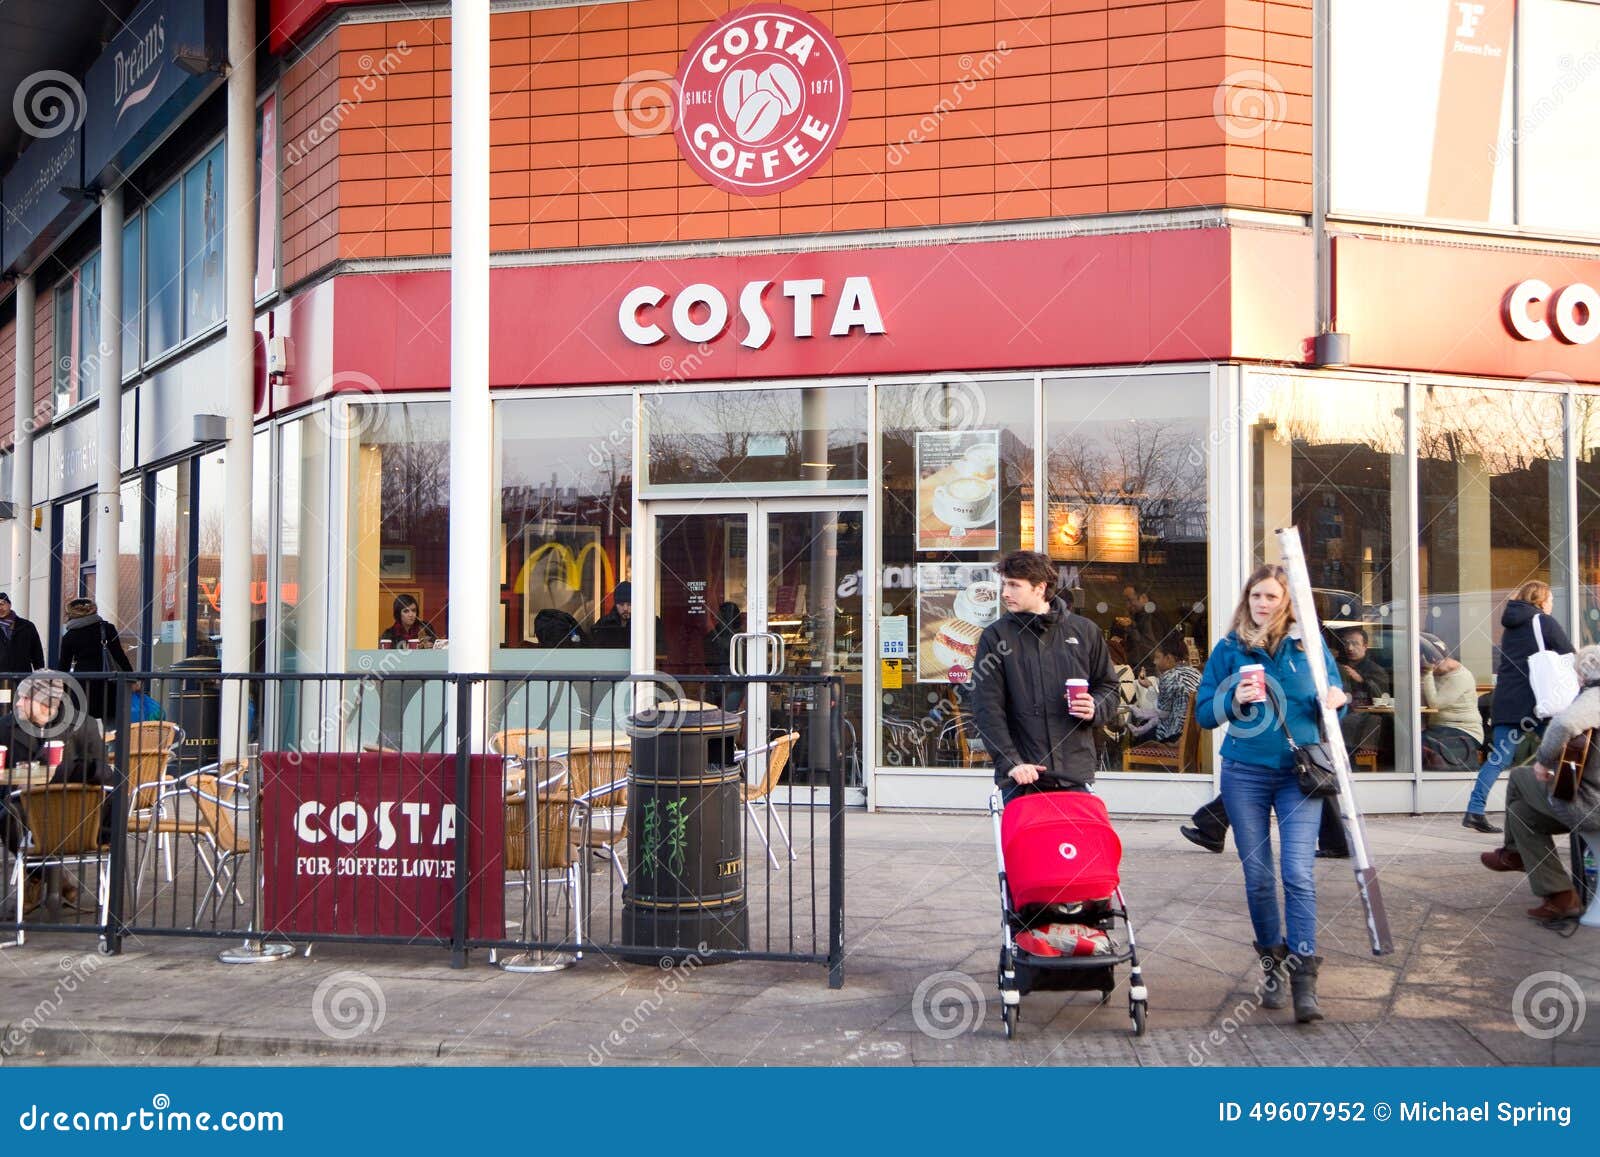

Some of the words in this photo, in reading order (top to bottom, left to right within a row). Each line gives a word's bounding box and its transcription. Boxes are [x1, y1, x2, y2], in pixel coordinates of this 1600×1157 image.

[114, 15, 165, 106] Dreams
[702, 20, 815, 74] COSTA
[686, 90, 713, 105] SINCE
[811, 80, 833, 95] 1971
[694, 115, 830, 179] COFFEE
[618, 276, 887, 349] COSTA
[1502, 278, 1600, 345] CO
[297, 857, 332, 876] FOR
[337, 857, 398, 877] COFFEE
[401, 859, 456, 879] LOVER
